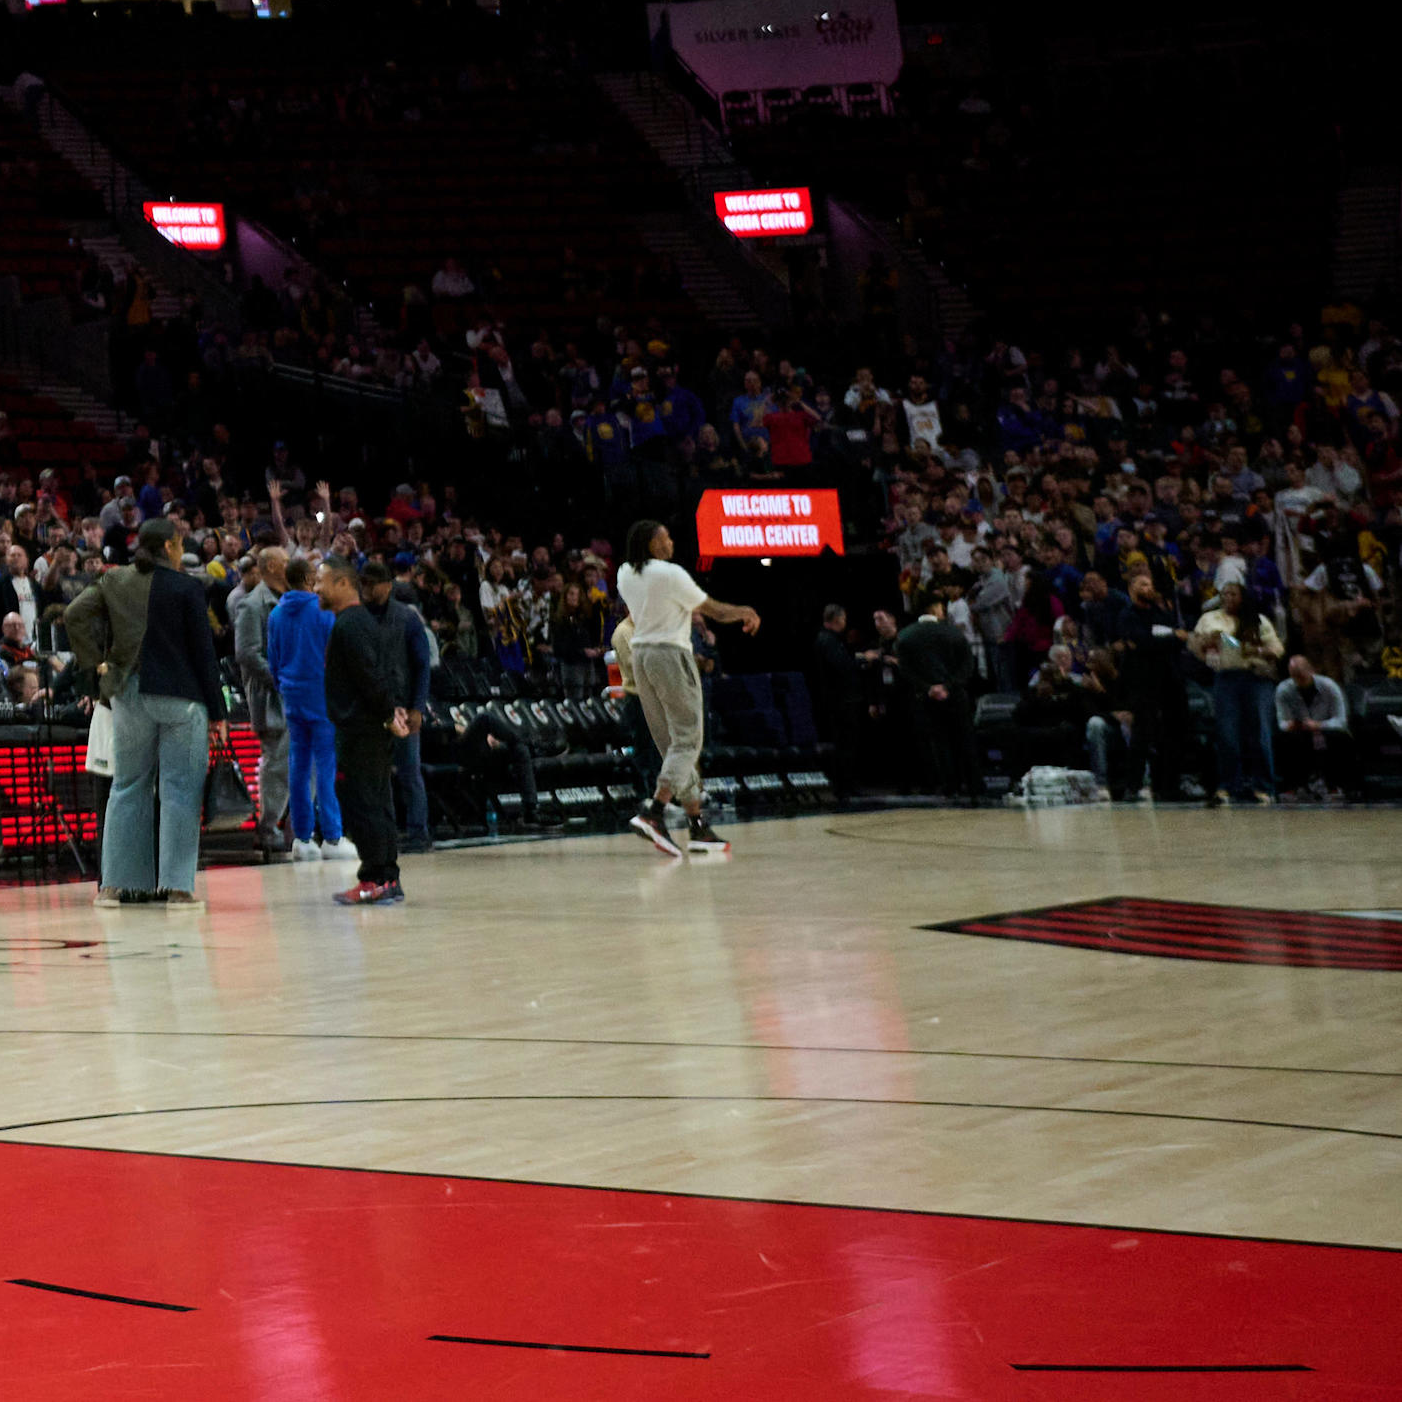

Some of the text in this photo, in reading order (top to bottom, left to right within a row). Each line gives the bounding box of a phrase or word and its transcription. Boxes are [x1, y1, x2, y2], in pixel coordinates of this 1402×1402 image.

[724, 192, 801, 213] WELCOME TO
[152, 206, 217, 225] WELCOME TO
[760, 210, 807, 231] CENTER
[721, 494, 811, 517] WELCOME TO
[721, 524, 819, 547] MODA CENTER
